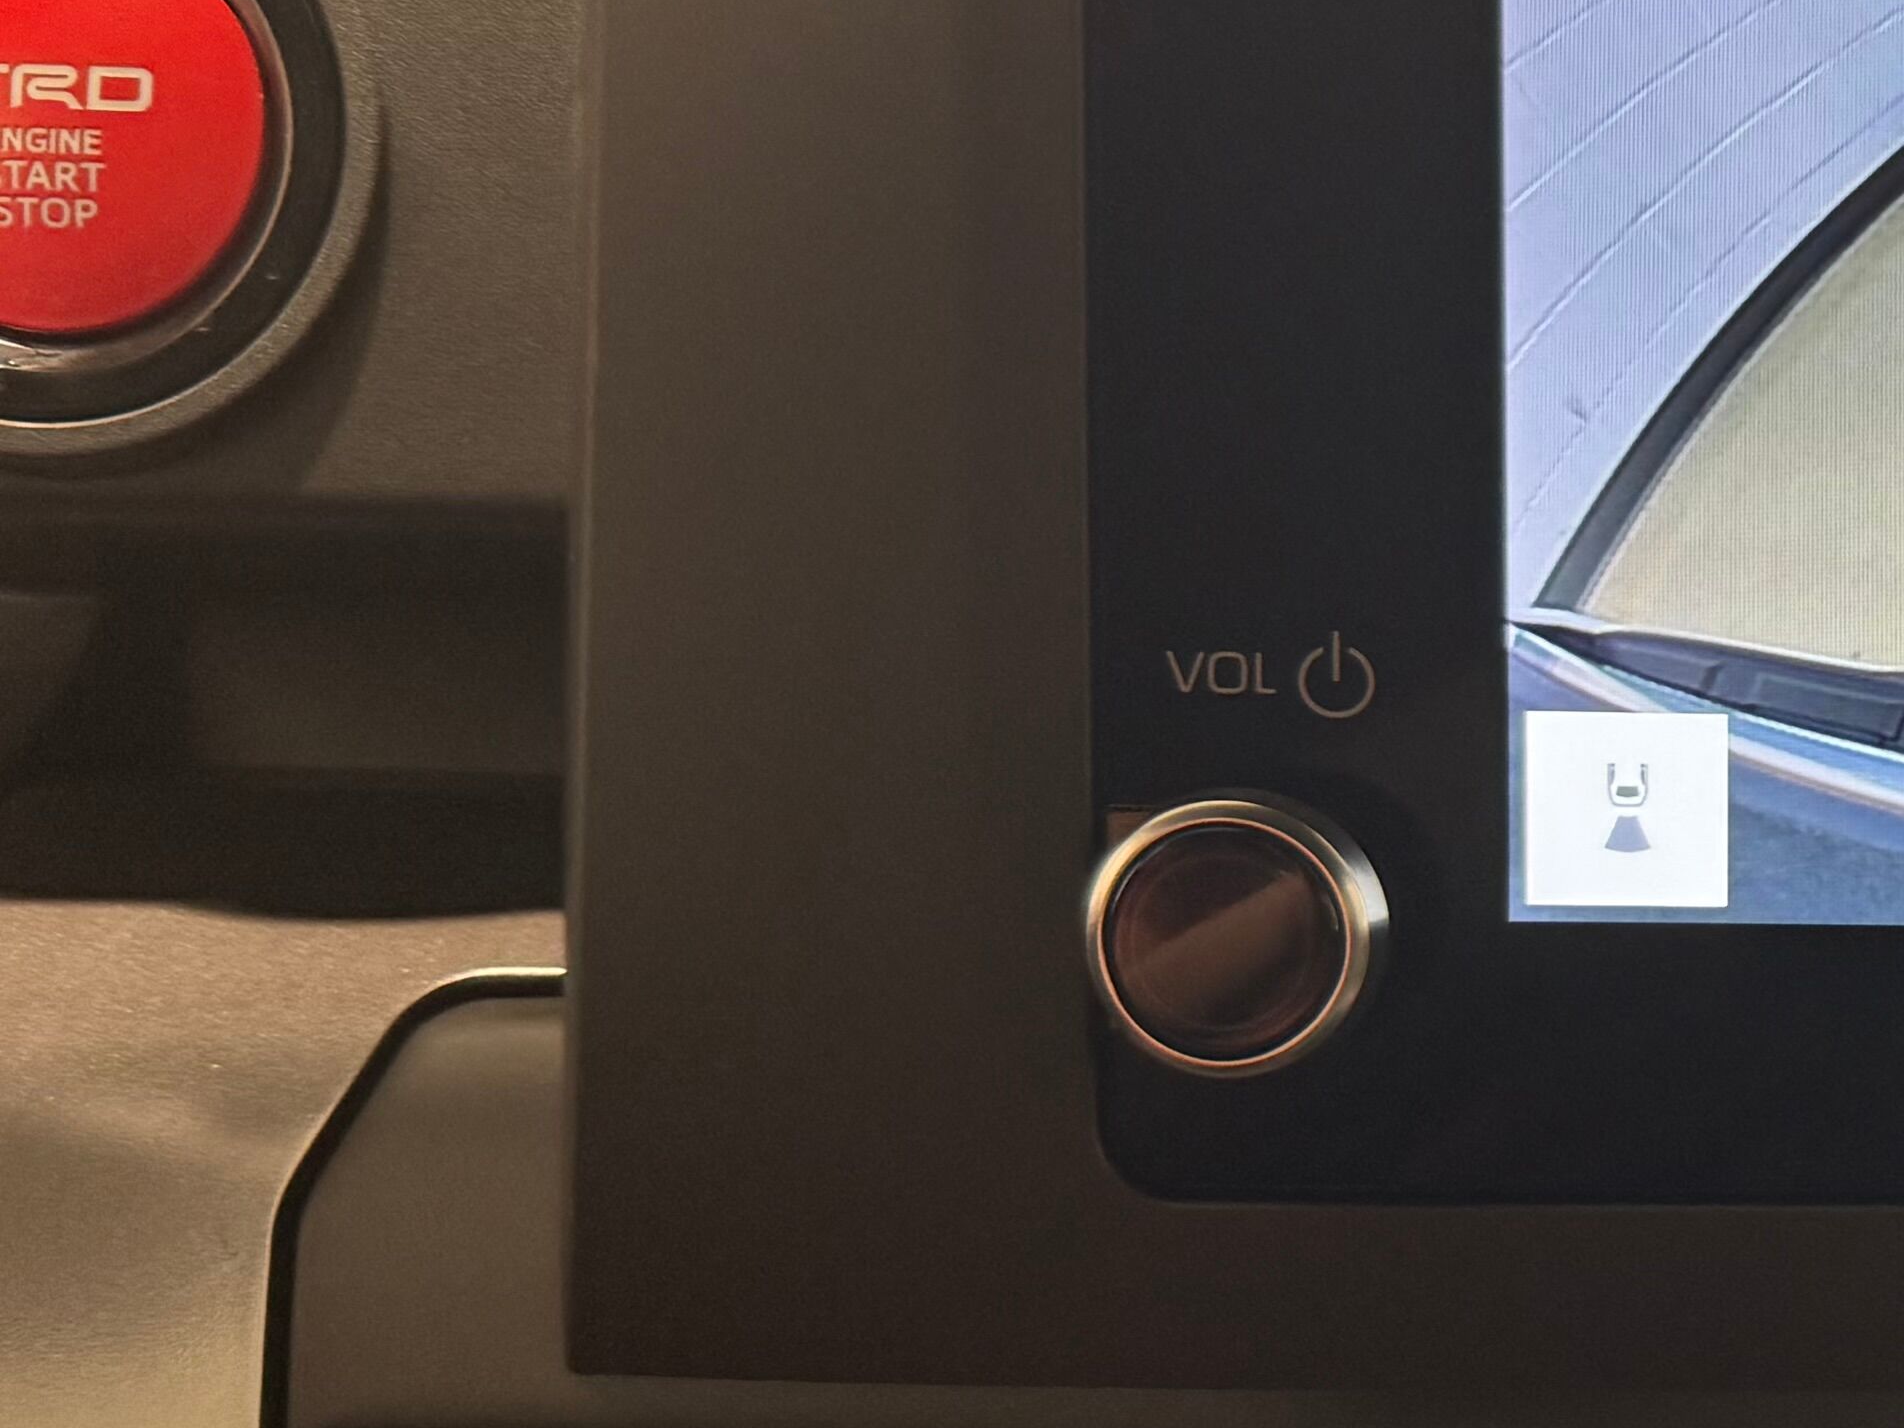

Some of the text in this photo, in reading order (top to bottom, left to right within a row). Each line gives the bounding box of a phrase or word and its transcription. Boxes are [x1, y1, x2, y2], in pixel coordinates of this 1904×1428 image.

[0, 63, 154, 112] RD
[0, 128, 103, 156] NGINE
[0, 160, 107, 193] TART
[1165, 650, 1277, 695] VOL
